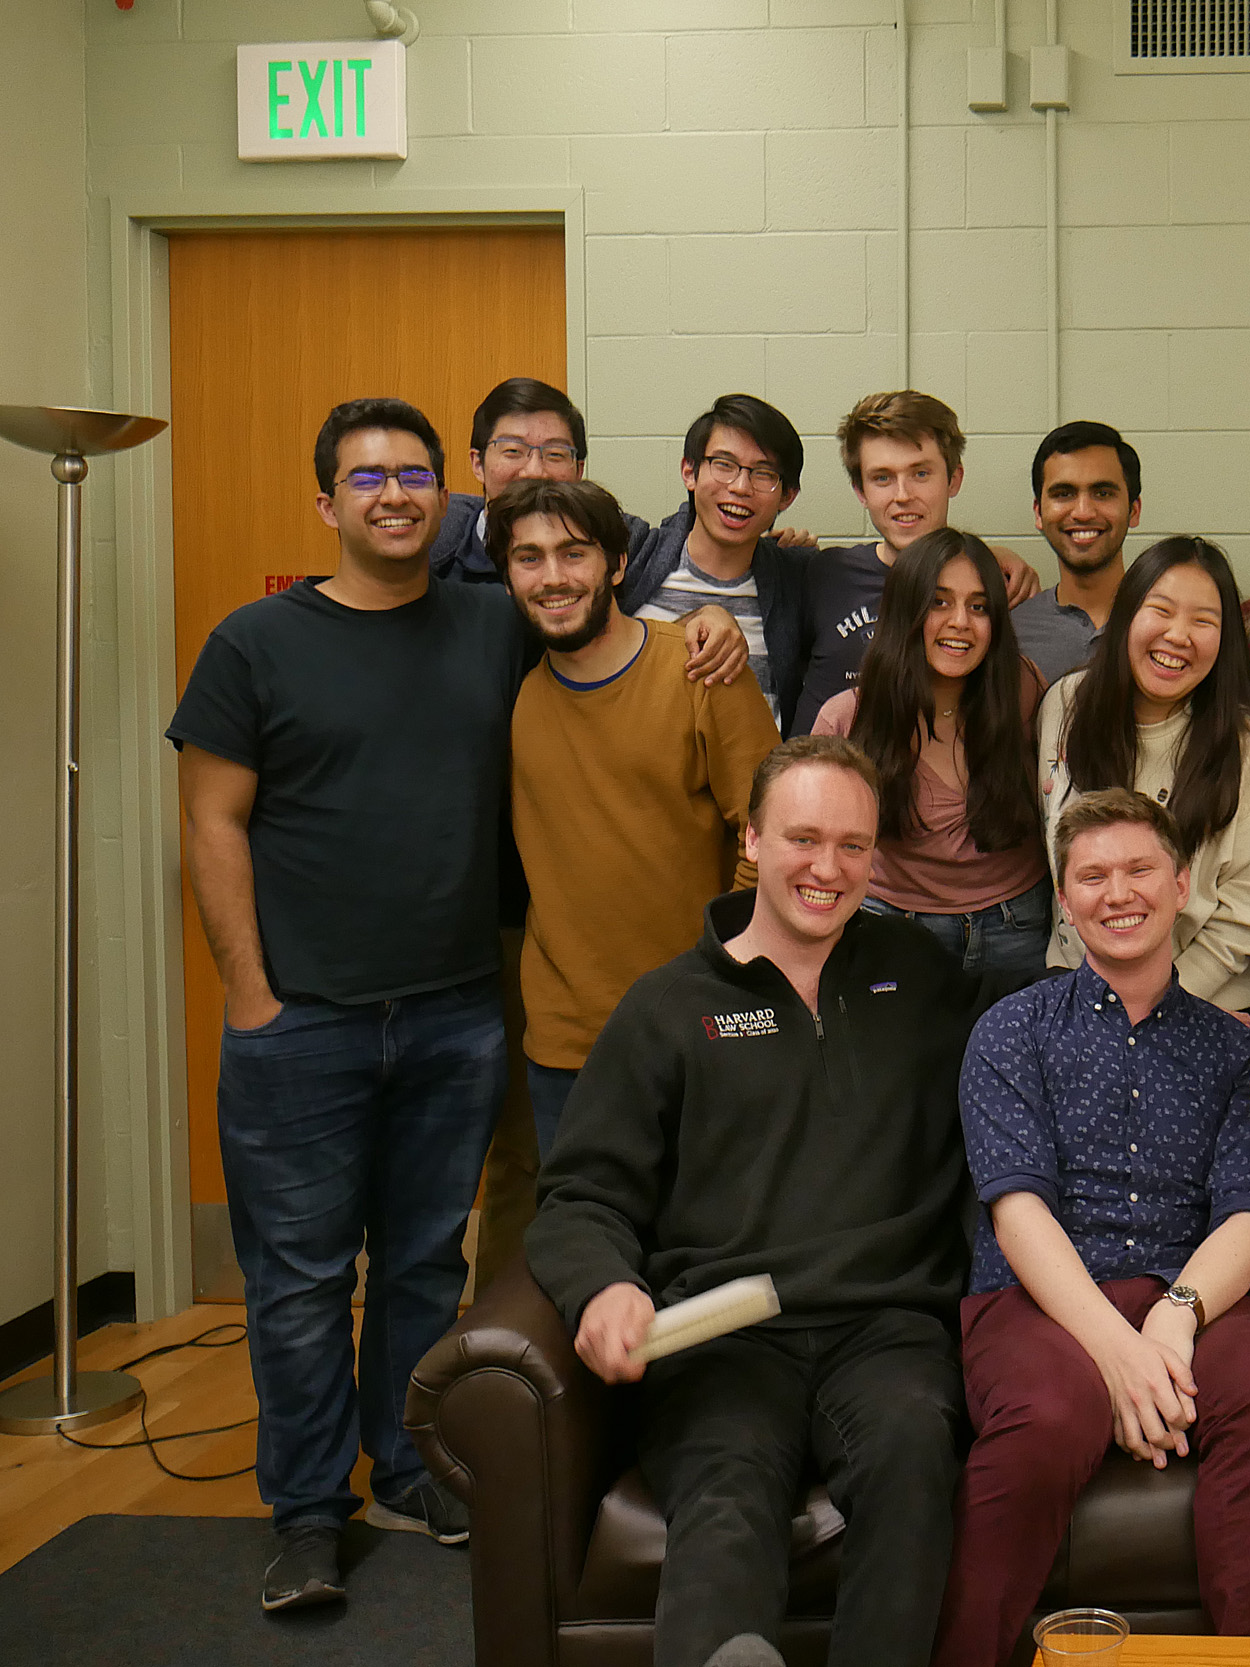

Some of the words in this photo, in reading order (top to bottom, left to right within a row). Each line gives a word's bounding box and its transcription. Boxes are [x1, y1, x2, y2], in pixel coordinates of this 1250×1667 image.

[268, 58, 372, 139] EXIT
[265, 576, 305, 597] EM
[714, 1008, 775, 1025] HARVARD
[718, 1024, 737, 1032] LAW
[739, 1019, 777, 1031] SCHOOL
